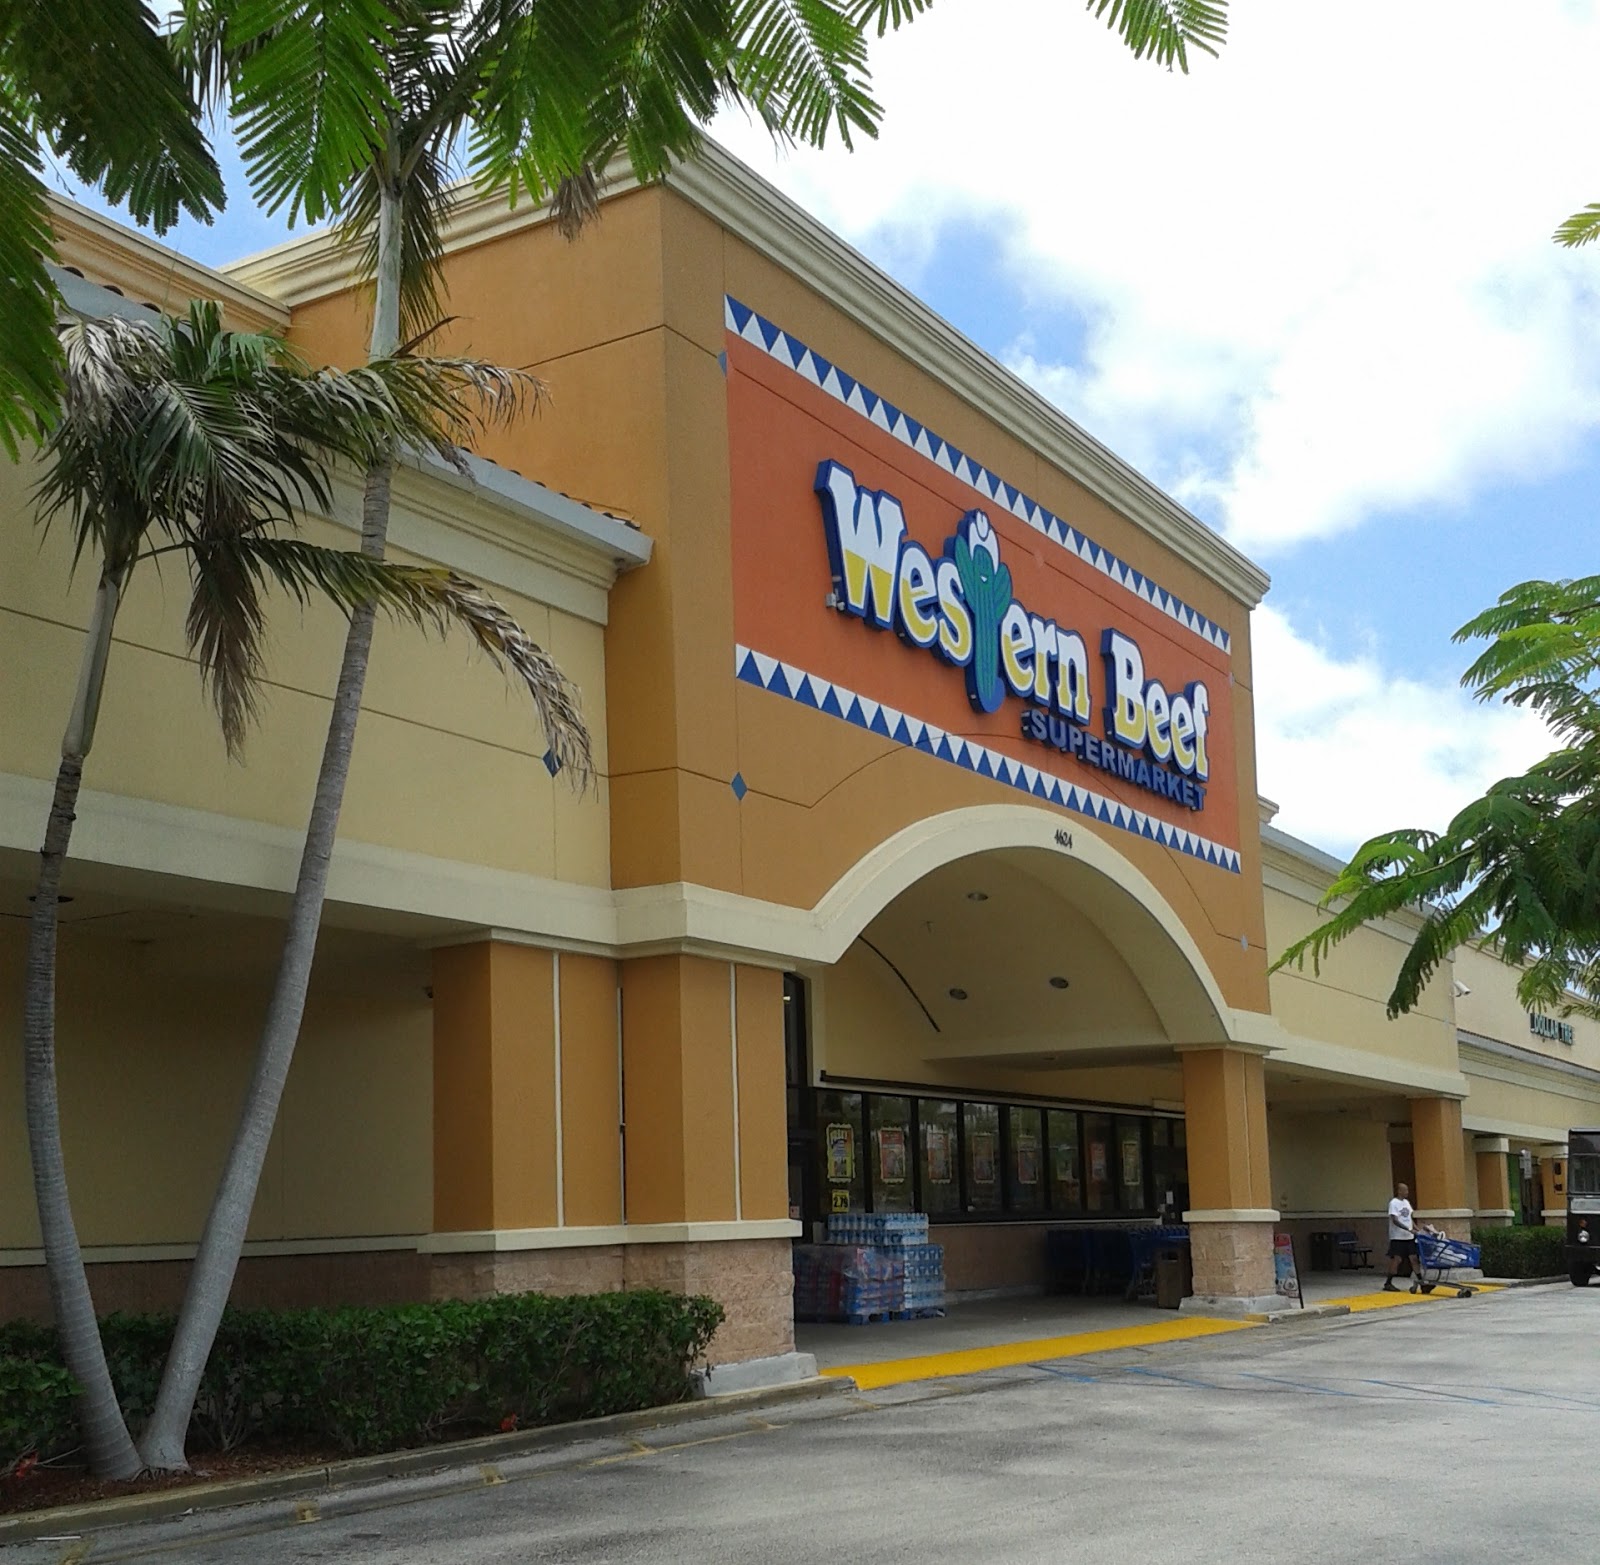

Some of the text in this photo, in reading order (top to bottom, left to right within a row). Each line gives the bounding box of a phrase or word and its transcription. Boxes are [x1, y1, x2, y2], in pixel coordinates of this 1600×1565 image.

[814, 459, 1210, 783] Western Beef
[1022, 709, 1206, 811] SUPERMARKET
[1054, 829, 1072, 849] 4624
